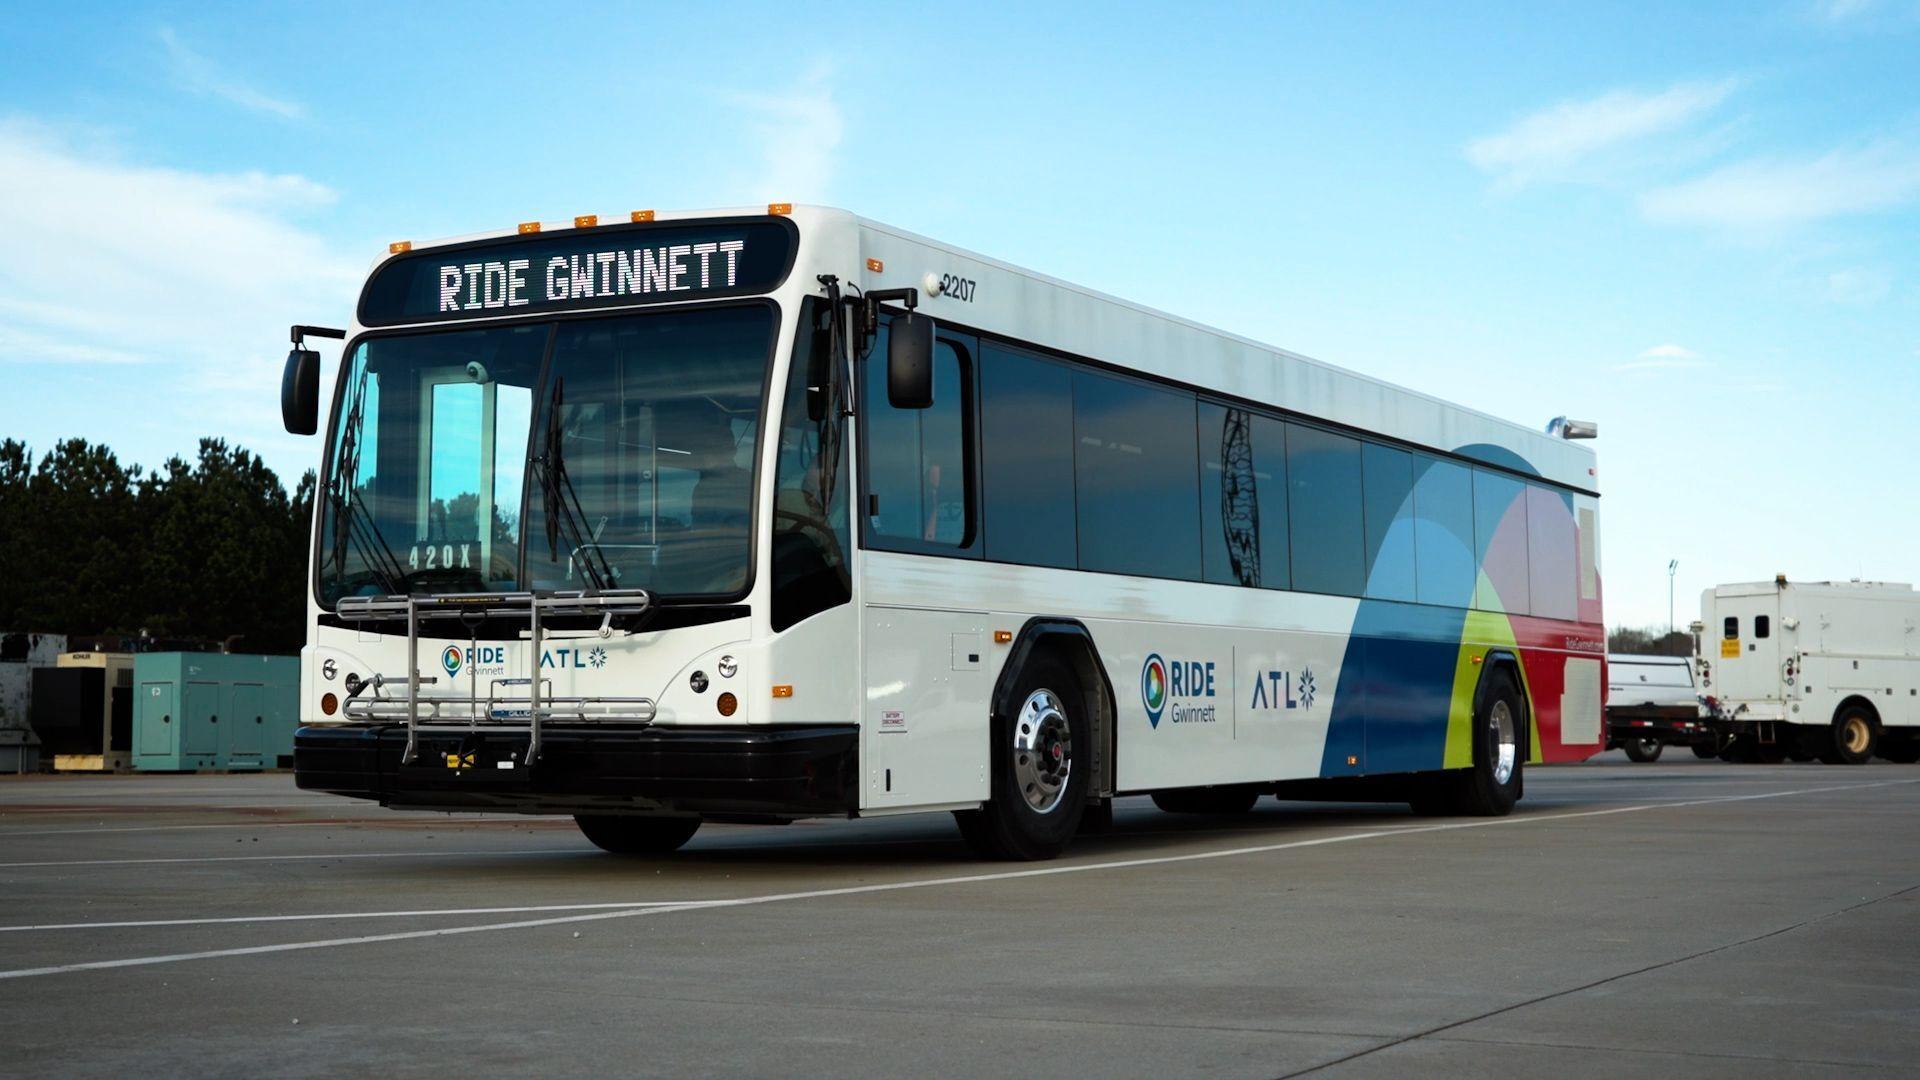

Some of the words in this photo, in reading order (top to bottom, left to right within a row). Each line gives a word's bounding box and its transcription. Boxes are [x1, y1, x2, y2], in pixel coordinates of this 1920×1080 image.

[440, 259, 530, 312] RIDE
[546, 240, 744, 300] GWINNETT
[943, 273, 976, 303] 2207
[409, 544, 471, 570] 420X
[466, 647, 504, 663] RIDE
[540, 649, 586, 668] ATL
[1171, 661, 1215, 697] RIDE
[1251, 670, 1297, 709] ATL
[1171, 702, 1216, 723] Gwinnett
